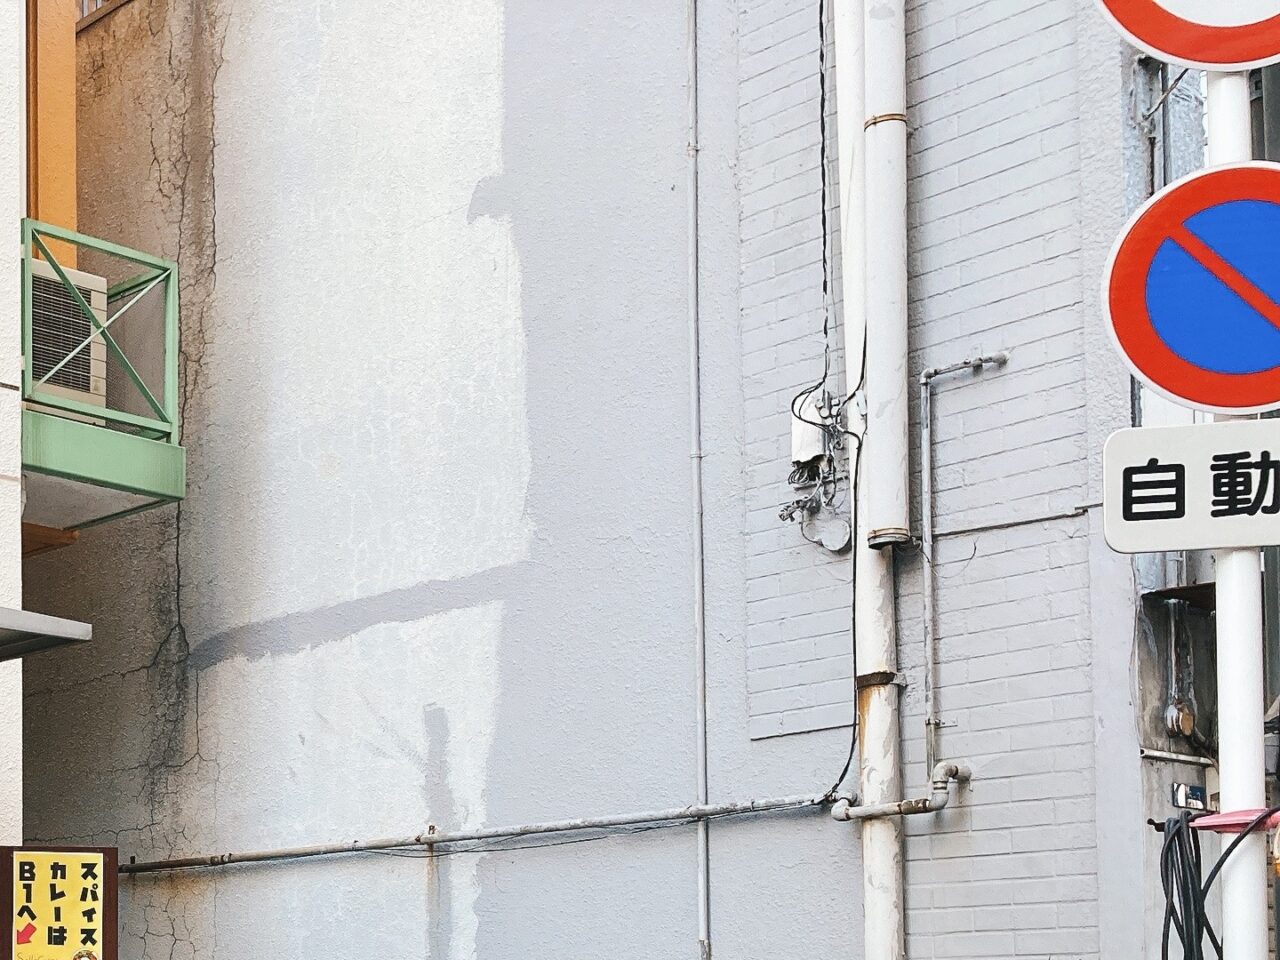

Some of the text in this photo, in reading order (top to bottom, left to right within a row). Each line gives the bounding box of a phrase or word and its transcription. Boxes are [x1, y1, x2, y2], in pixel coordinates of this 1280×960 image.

[17, 861, 37, 921] B1へ
[48, 862, 68, 946] カレーは
[80, 863, 99, 946] スパイス
